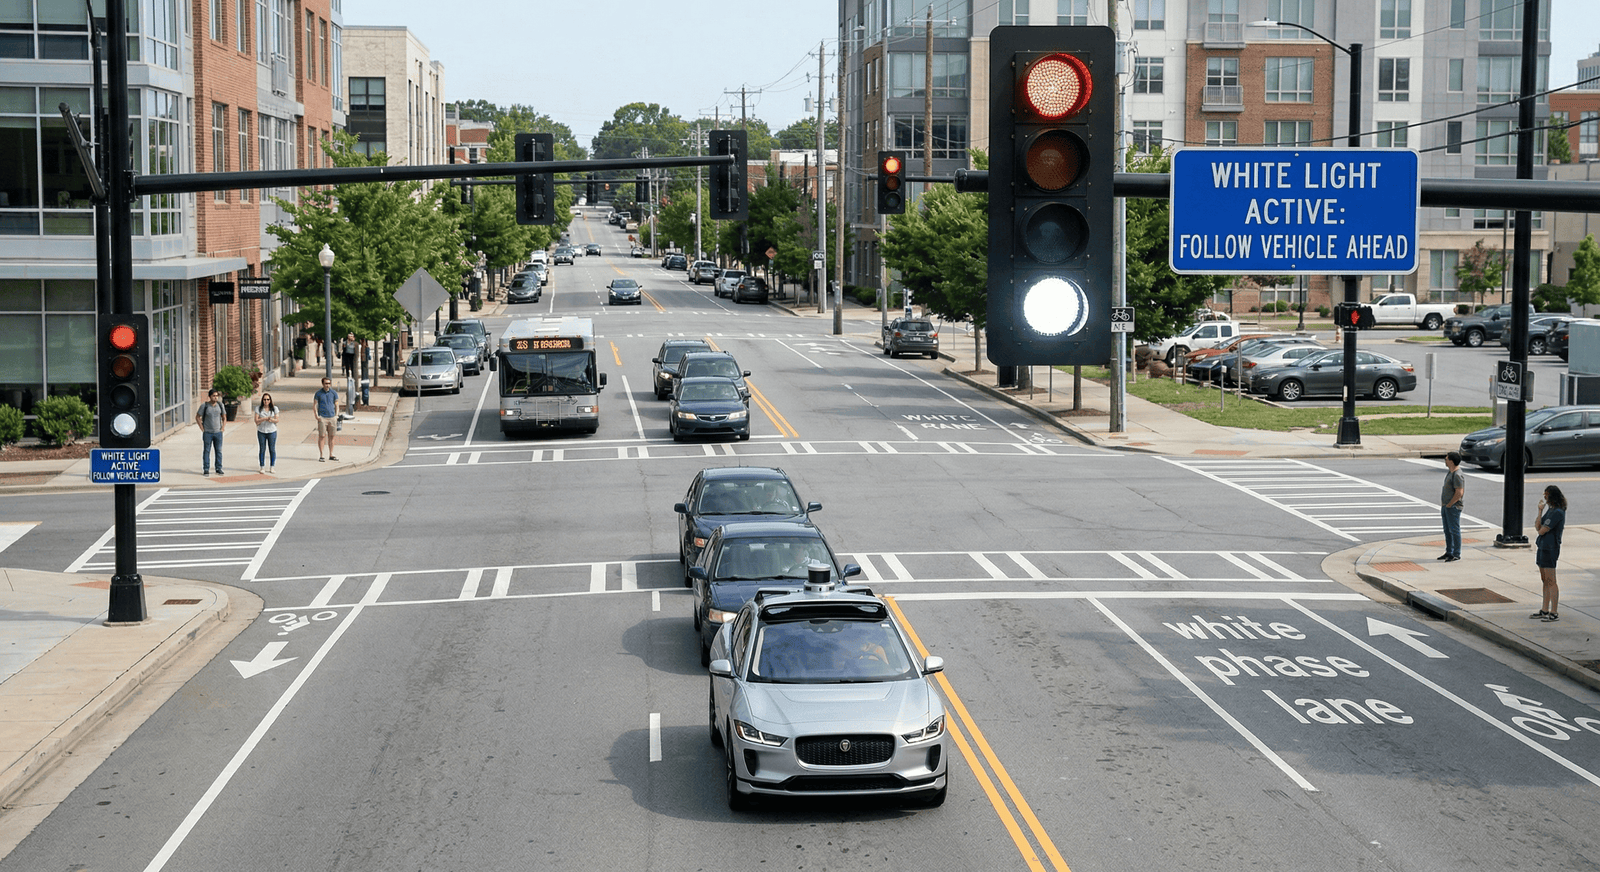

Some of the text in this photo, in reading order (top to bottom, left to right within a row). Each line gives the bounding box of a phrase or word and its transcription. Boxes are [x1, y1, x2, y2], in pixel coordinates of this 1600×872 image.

[1211, 162, 1381, 189] WHITE LIGHT
[1244, 198, 1346, 225] ACTIVE:
[1179, 234, 1408, 259] FOLLOW VEHICLE AHEAD
[101, 452, 150, 460] WHITE LIGHT
[93, 472, 159, 480] FOLLOW VEHICLE AHEAD
[1162, 615, 1306, 640] white
[1194, 648, 1370, 686] phase
[1261, 689, 1414, 725] lane
